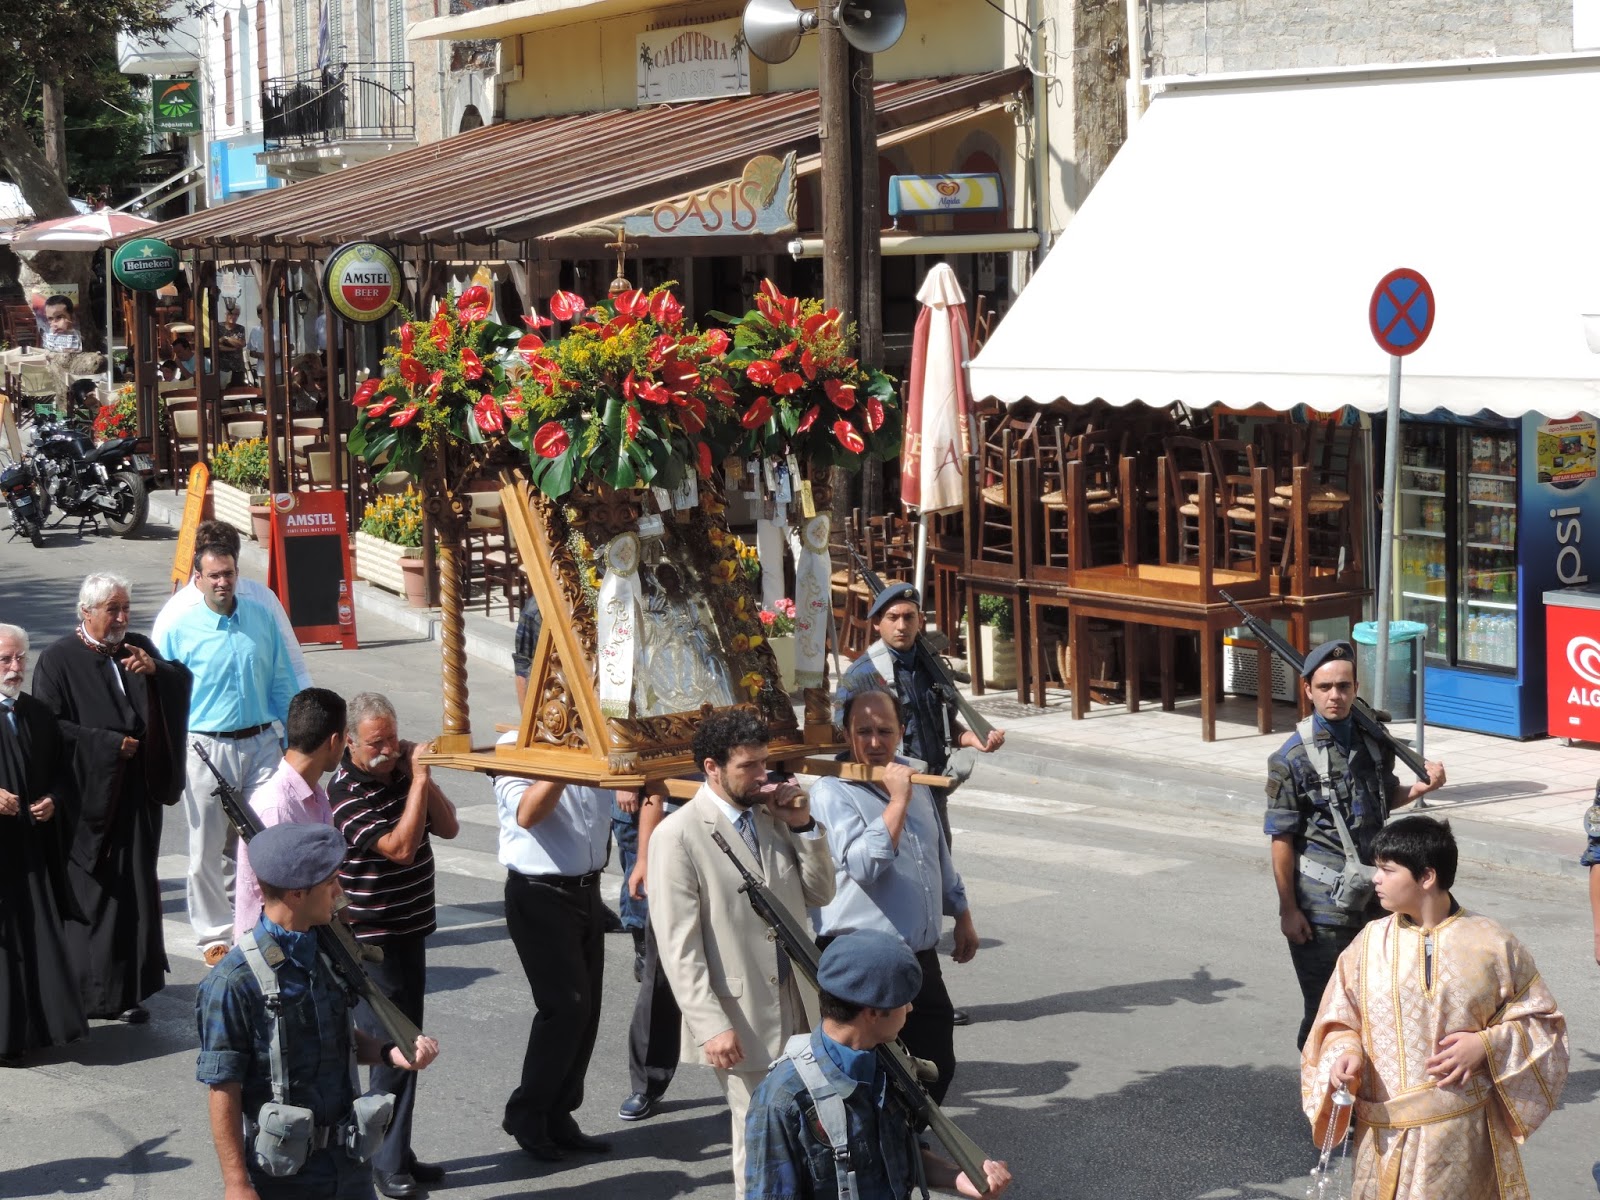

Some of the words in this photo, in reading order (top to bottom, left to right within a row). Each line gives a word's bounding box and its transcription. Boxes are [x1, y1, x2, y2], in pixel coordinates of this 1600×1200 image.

[654, 31, 729, 69] CAFETERIA
[667, 69, 716, 98] OASIS
[653, 181, 762, 233] OASIS
[938, 197, 961, 208] Algida
[126, 260, 170, 271] Heineken
[344, 272, 389, 284] AMSTEL
[354, 288, 379, 297] BEER
[286, 513, 336, 527] AMSTEL
